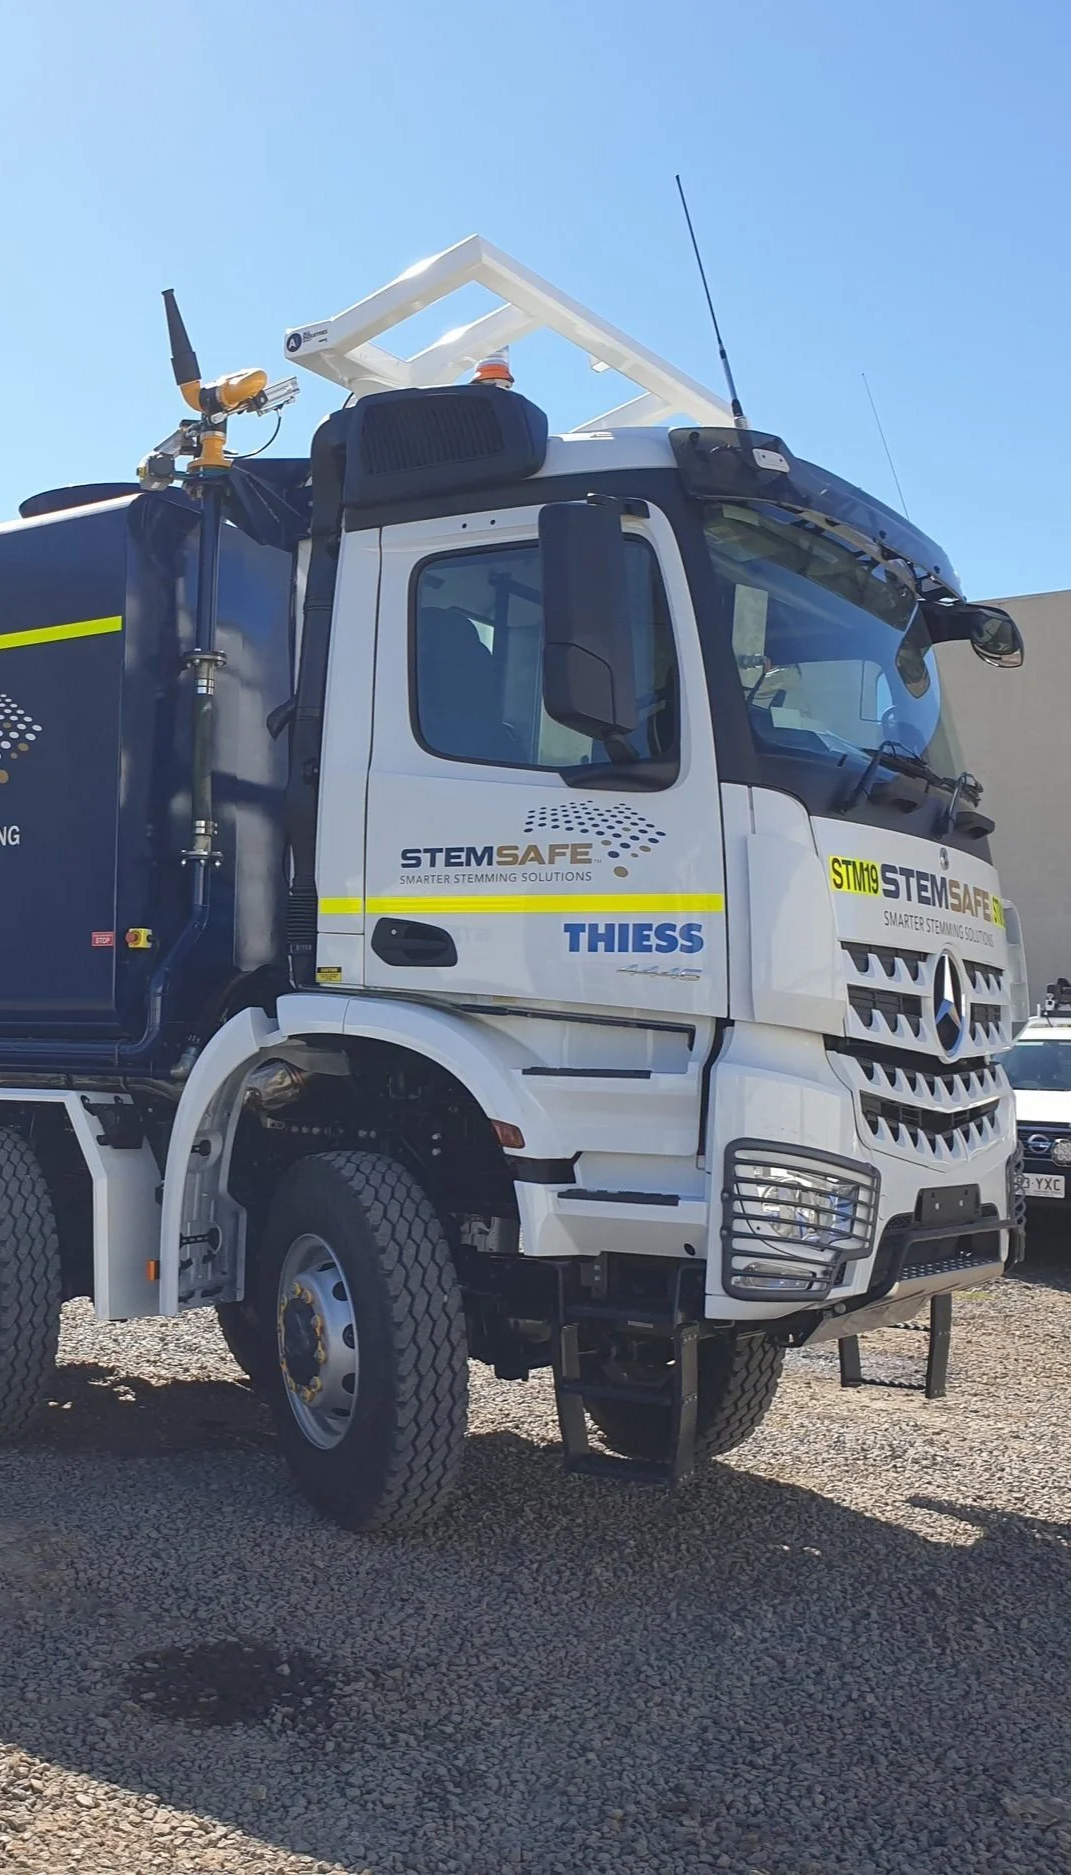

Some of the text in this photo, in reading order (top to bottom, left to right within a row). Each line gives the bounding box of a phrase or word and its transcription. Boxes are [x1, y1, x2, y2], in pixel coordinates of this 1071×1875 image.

[400, 843, 593, 869] STEMSAFE
[400, 871, 592, 885] SMARTER STEMMING SOLUTIONS
[831, 857, 879, 894] STM19
[881, 863, 991, 923] STEMSAFE
[563, 922, 704, 953] THIESS
[883, 910, 925, 932] SMARTER
[926, 918, 964, 940] STEMMING
